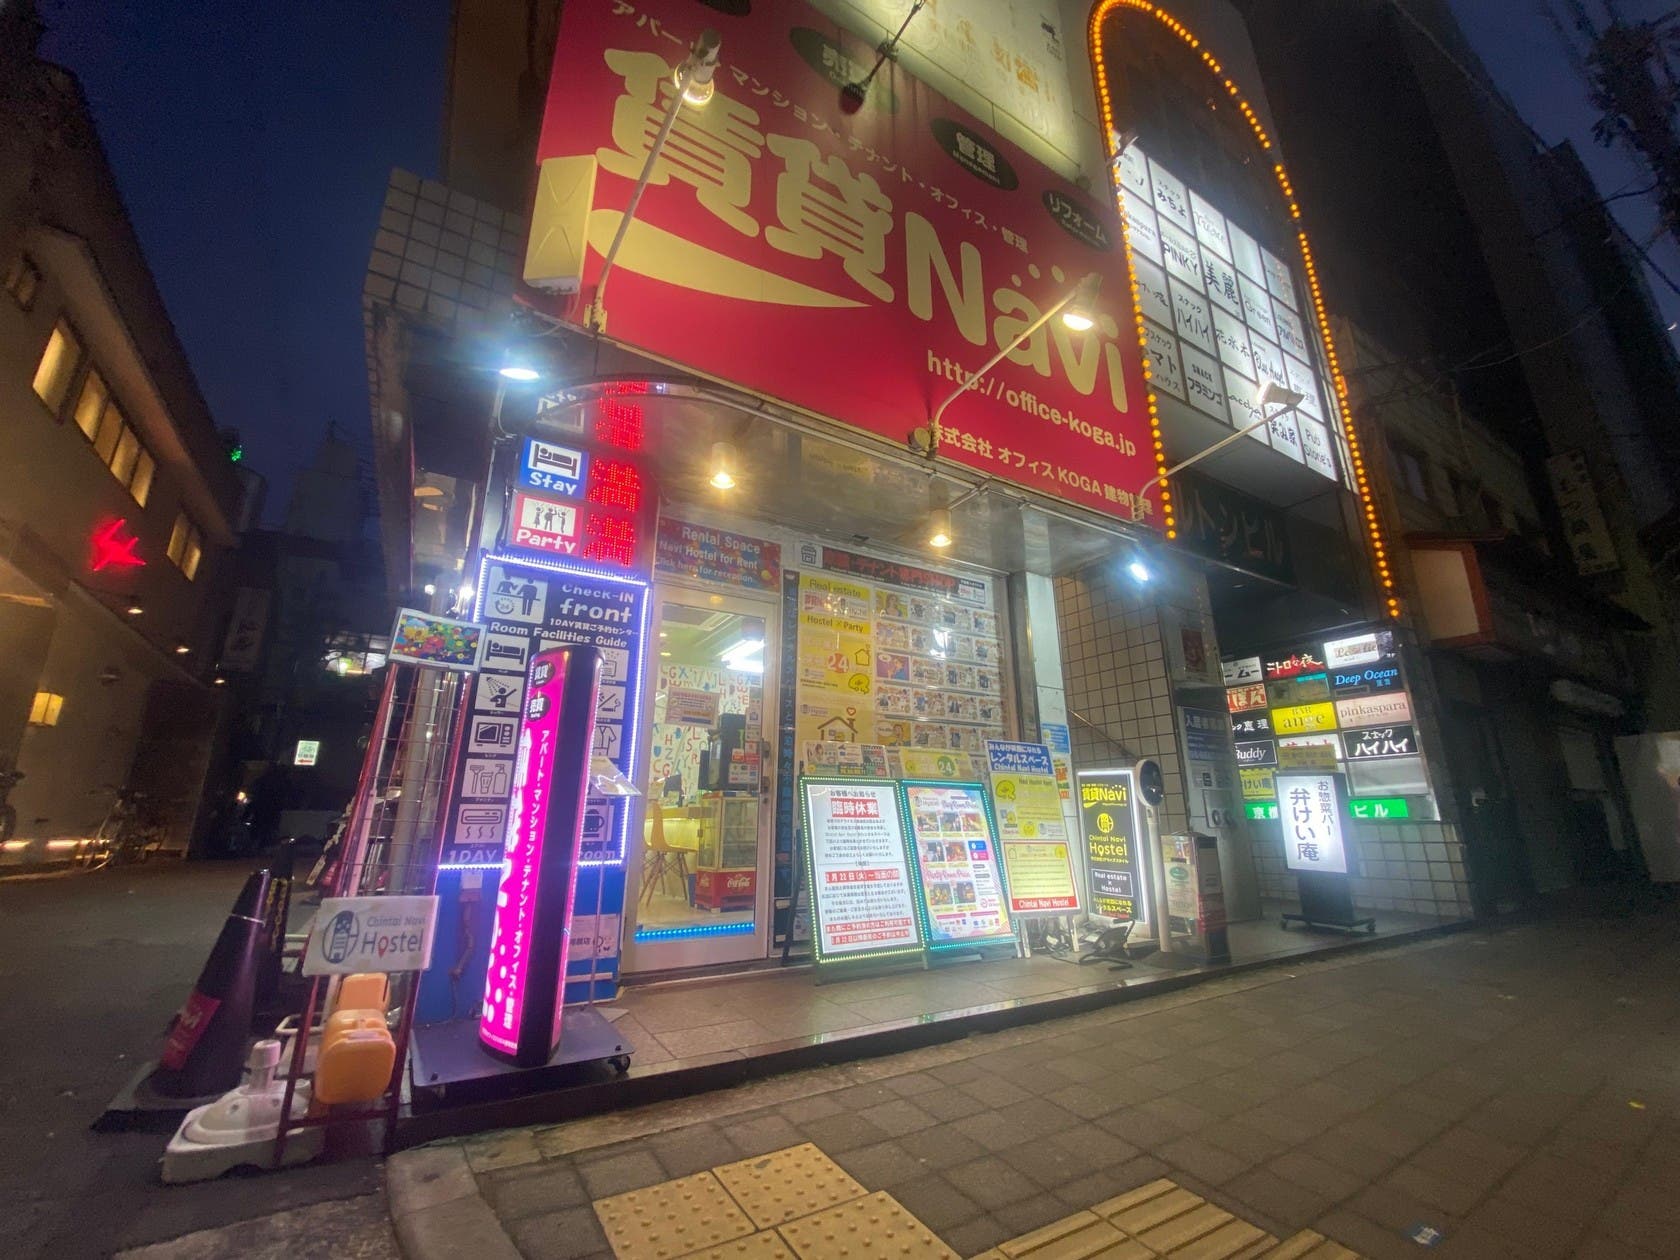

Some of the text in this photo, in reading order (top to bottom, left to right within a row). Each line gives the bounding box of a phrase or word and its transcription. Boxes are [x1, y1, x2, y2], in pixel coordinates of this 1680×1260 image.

[956, 131, 997, 172] 管理
[1048, 193, 1106, 246] リフォーム
[1162, 239, 1199, 276] PINKY
[1177, 308, 1210, 342] ハイハイ
[529, 471, 578, 496] Stay
[517, 528, 577, 554] Party
[682, 526, 760, 555] Rental Space
[685, 545, 717, 561] Hostel
[720, 554, 735, 565] for
[561, 583, 634, 604] Check-IN
[809, 580, 831, 593] Real
[559, 597, 632, 623] front
[489, 620, 628, 648] Room Facilities Guide
[806, 615, 865, 634] Hostel Party
[1335, 673, 1362, 686] Deep
[1364, 667, 1399, 680] Ocean
[1362, 728, 1394, 741] スナック
[1355, 738, 1408, 757] ハイハイ
[990, 752, 1049, 767] レンタルスペース
[831, 800, 880, 817] 臨時休業
[1353, 802, 1390, 819] ビル
[1289, 787, 1320, 862] 弁けい庵
[1089, 842, 1128, 858] Hostel
[1101, 884, 1122, 894] Hostel
[361, 929, 424, 958] Hostel
